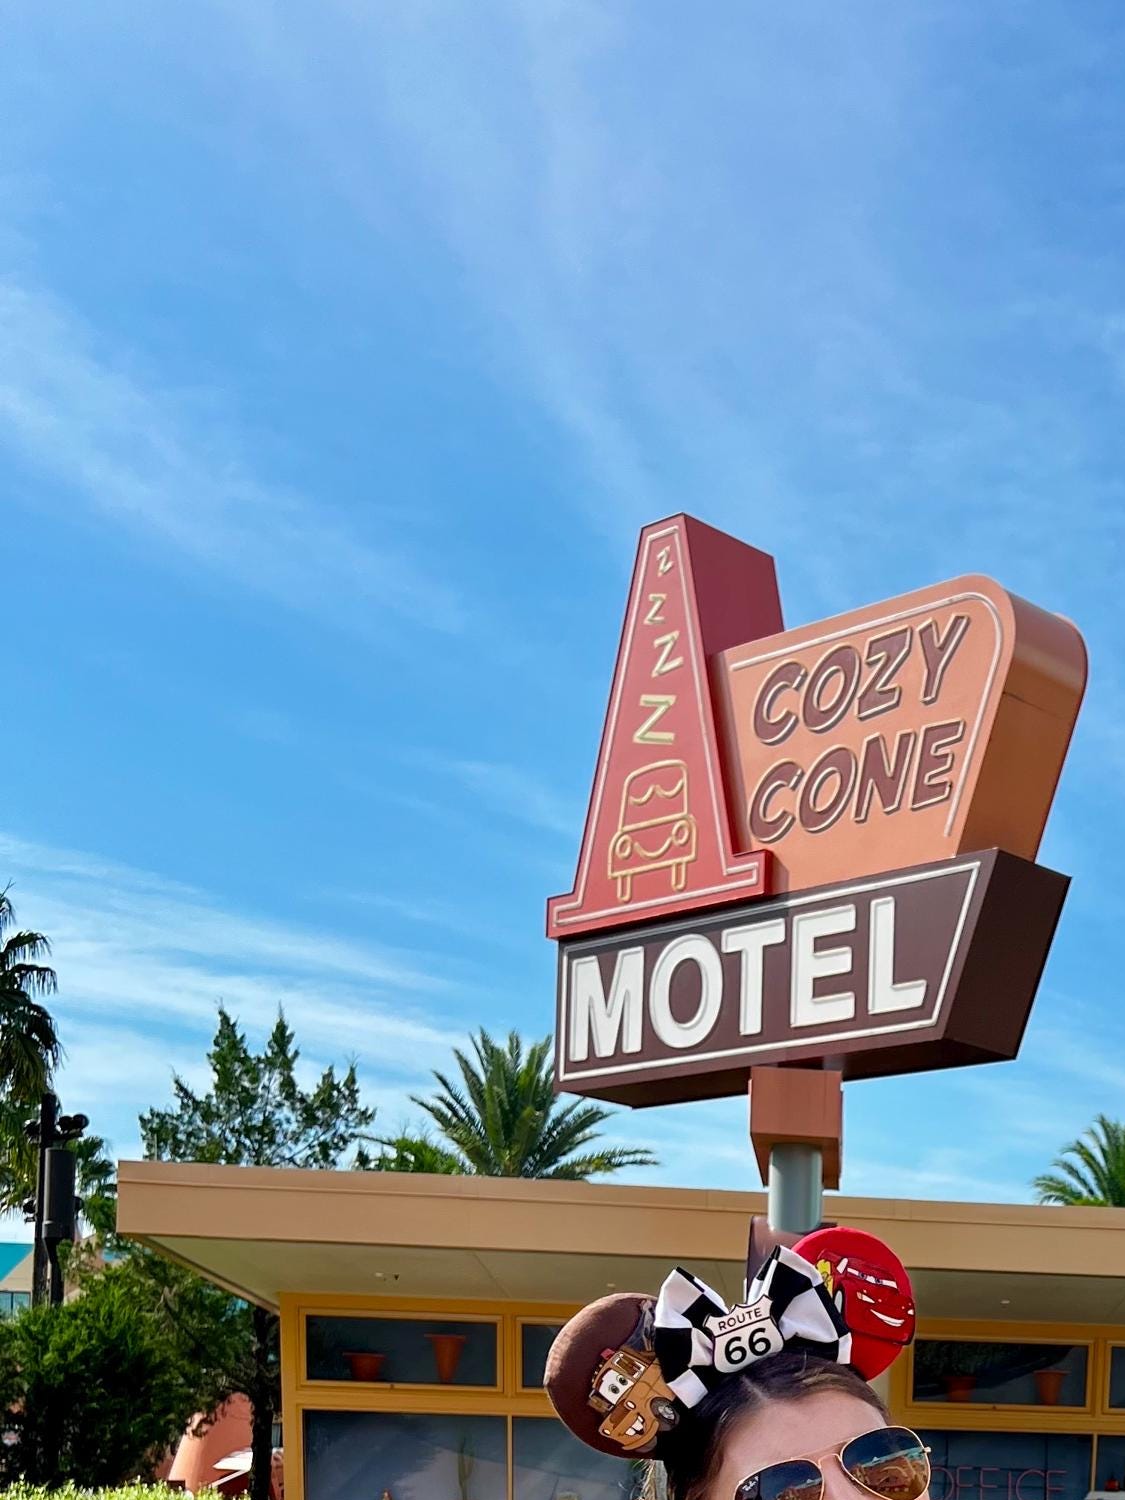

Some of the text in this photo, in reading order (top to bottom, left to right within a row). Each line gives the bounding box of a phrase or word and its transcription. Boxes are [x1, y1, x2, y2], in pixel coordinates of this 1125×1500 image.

[753, 613, 969, 746] COZY
[748, 720, 966, 843] CONE
[569, 896, 927, 1062] MOTEL
[718, 1307, 762, 1331] ROUTE
[725, 1327, 771, 1365] 66
